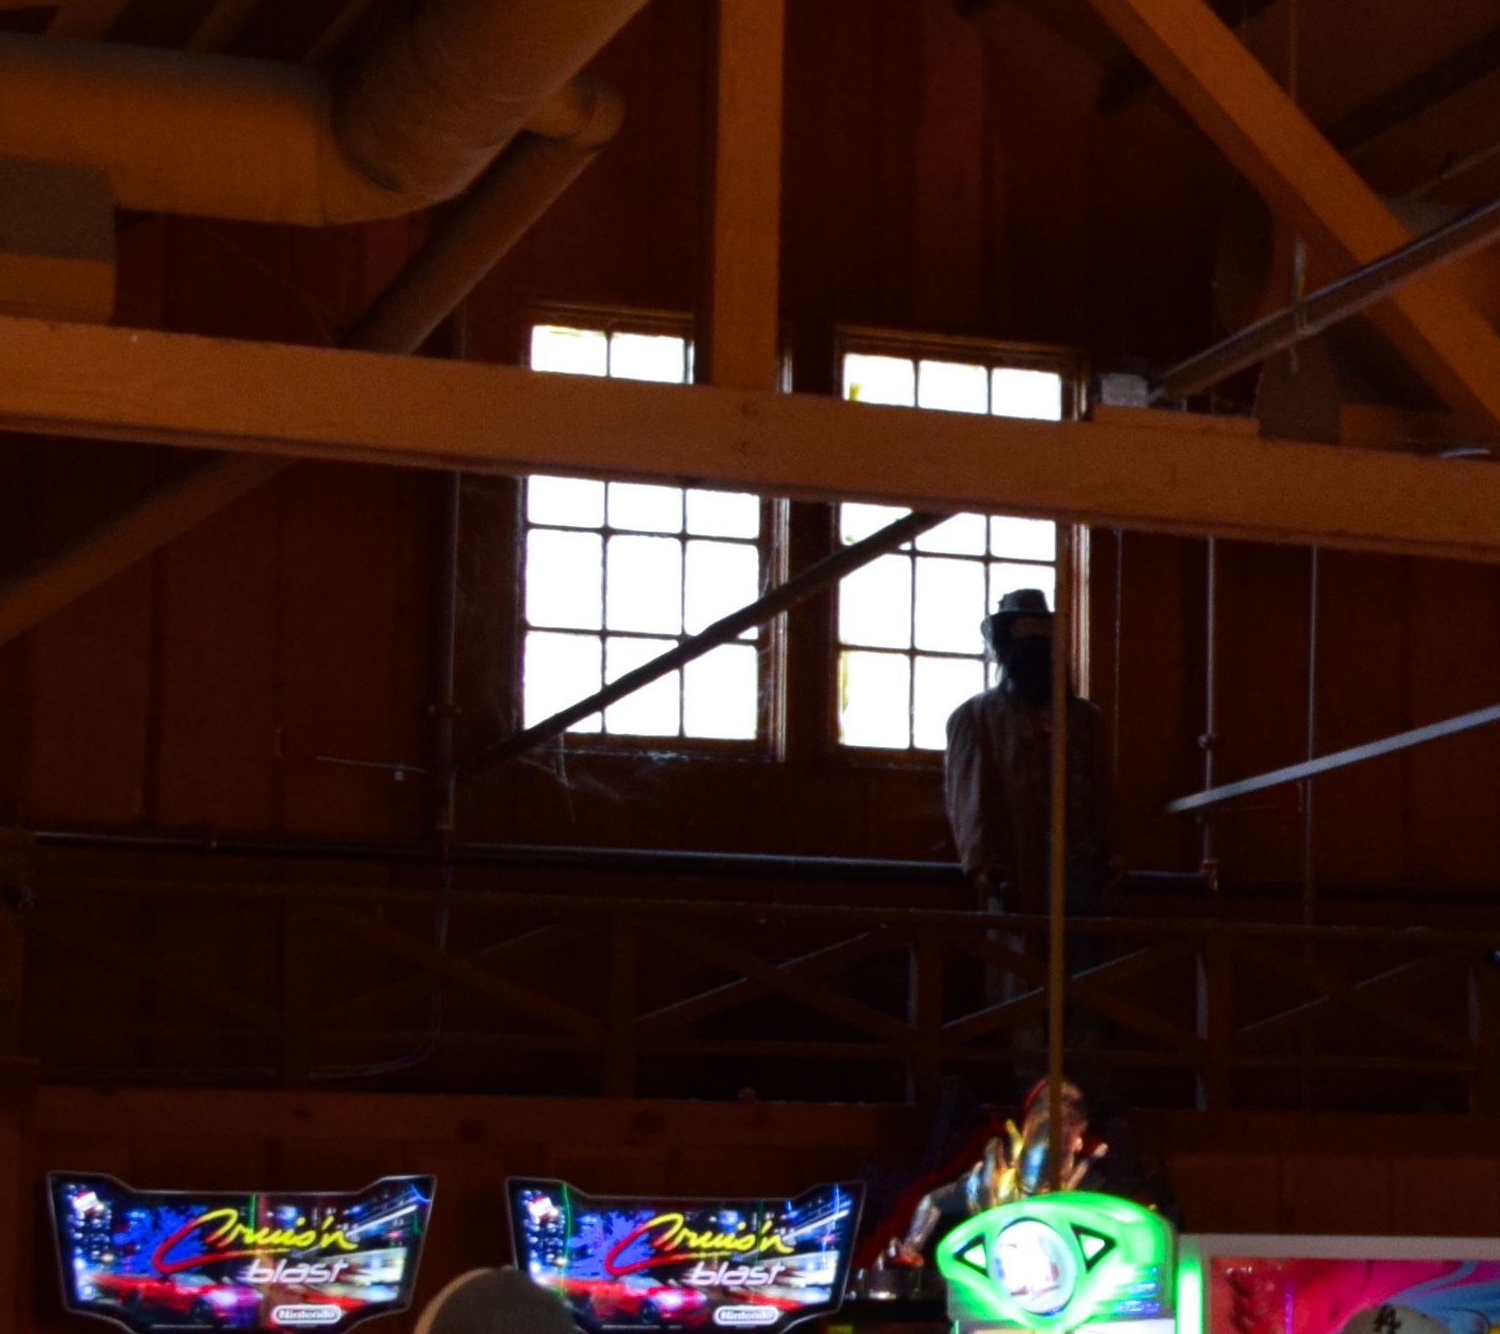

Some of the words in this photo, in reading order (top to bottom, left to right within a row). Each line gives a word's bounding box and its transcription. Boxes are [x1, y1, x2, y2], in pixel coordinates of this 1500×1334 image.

[152, 1208, 358, 1274] Cruis'n
[605, 1212, 795, 1275] Cruis'n
[248, 1258, 348, 1284] blast
[688, 1261, 785, 1287] blast
[277, 1307, 339, 1322] Nintendo
[718, 1309, 775, 1323] Nintendo
